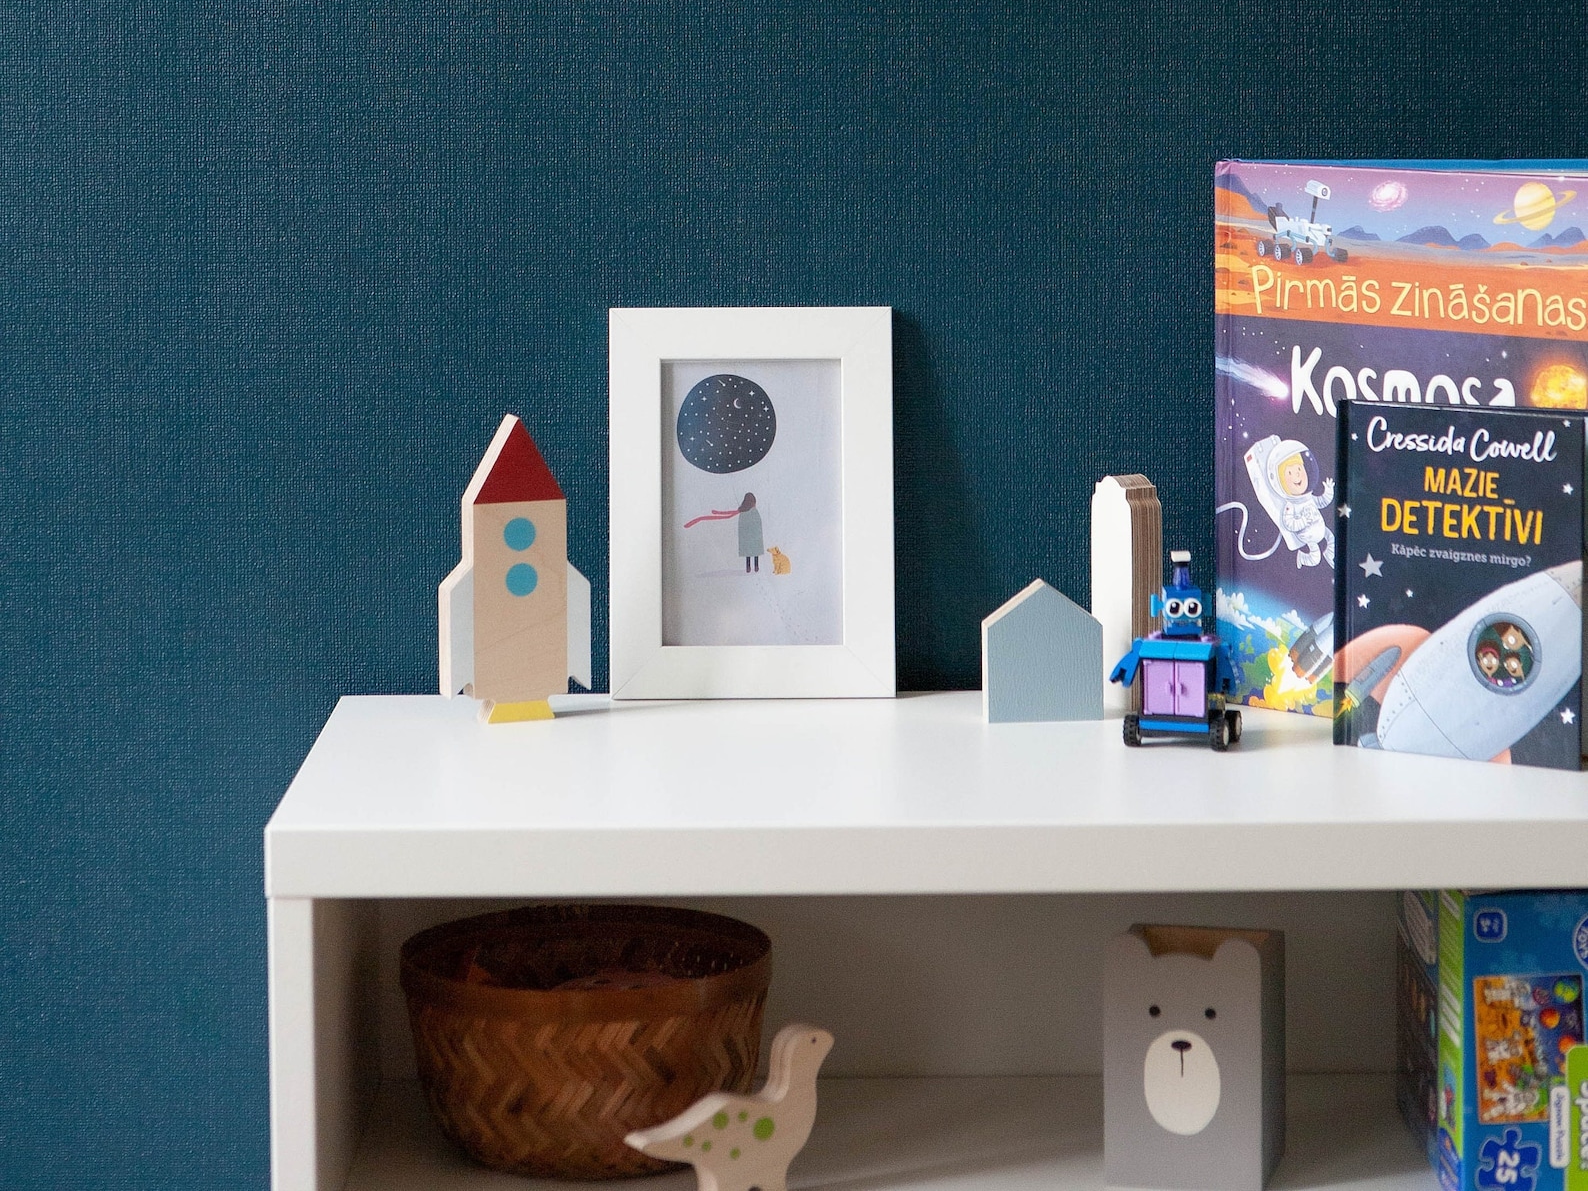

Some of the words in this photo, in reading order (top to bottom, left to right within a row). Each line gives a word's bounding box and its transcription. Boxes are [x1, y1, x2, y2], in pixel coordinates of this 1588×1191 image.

[1251, 265, 1381, 315] Pirmās
[1390, 280, 1587, 331] zināšanas
[1366, 415, 1466, 456] Cressida
[1470, 428, 1557, 463] Cowell
[1424, 466, 1500, 499] MAZIE
[1381, 497, 1543, 545] DETEKTĪVI
[1391, 542, 1428, 560] Kāpēc
[1429, 547, 1488, 565] zvaigznes
[1489, 551, 1532, 569] mirgo?
[1494, 1150, 1521, 1185] 25
